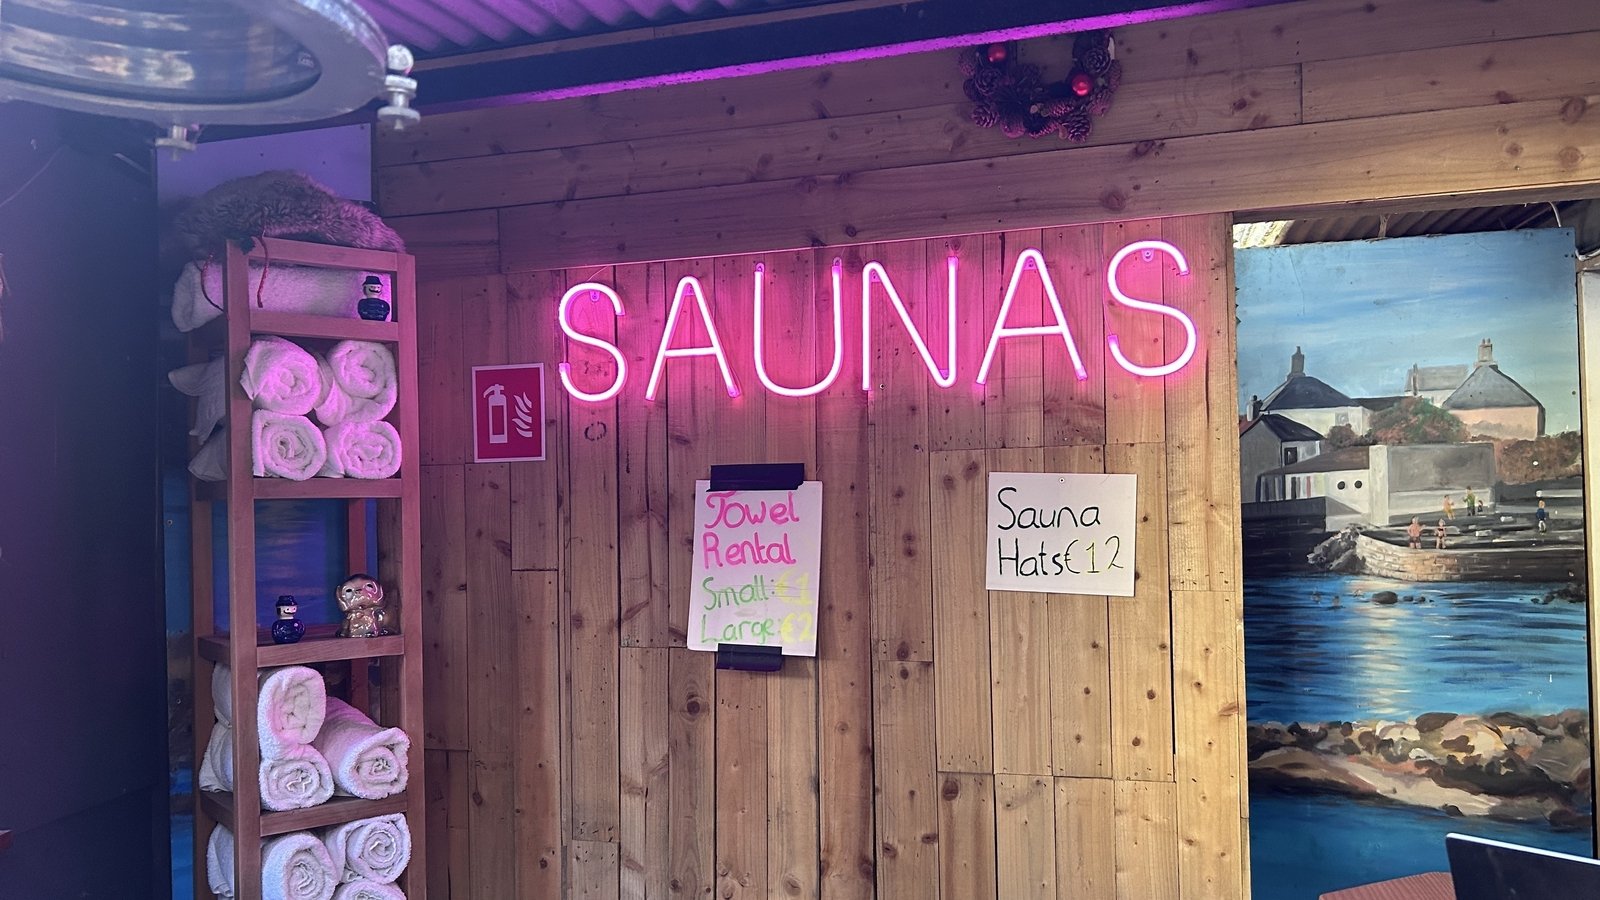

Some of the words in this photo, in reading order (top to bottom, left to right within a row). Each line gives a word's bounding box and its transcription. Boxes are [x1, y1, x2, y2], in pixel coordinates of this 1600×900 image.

[557, 240, 1198, 403] SAUNAS
[704, 491, 800, 529] Towel
[997, 486, 1101, 530] Sauna
[702, 531, 797, 570] Rental
